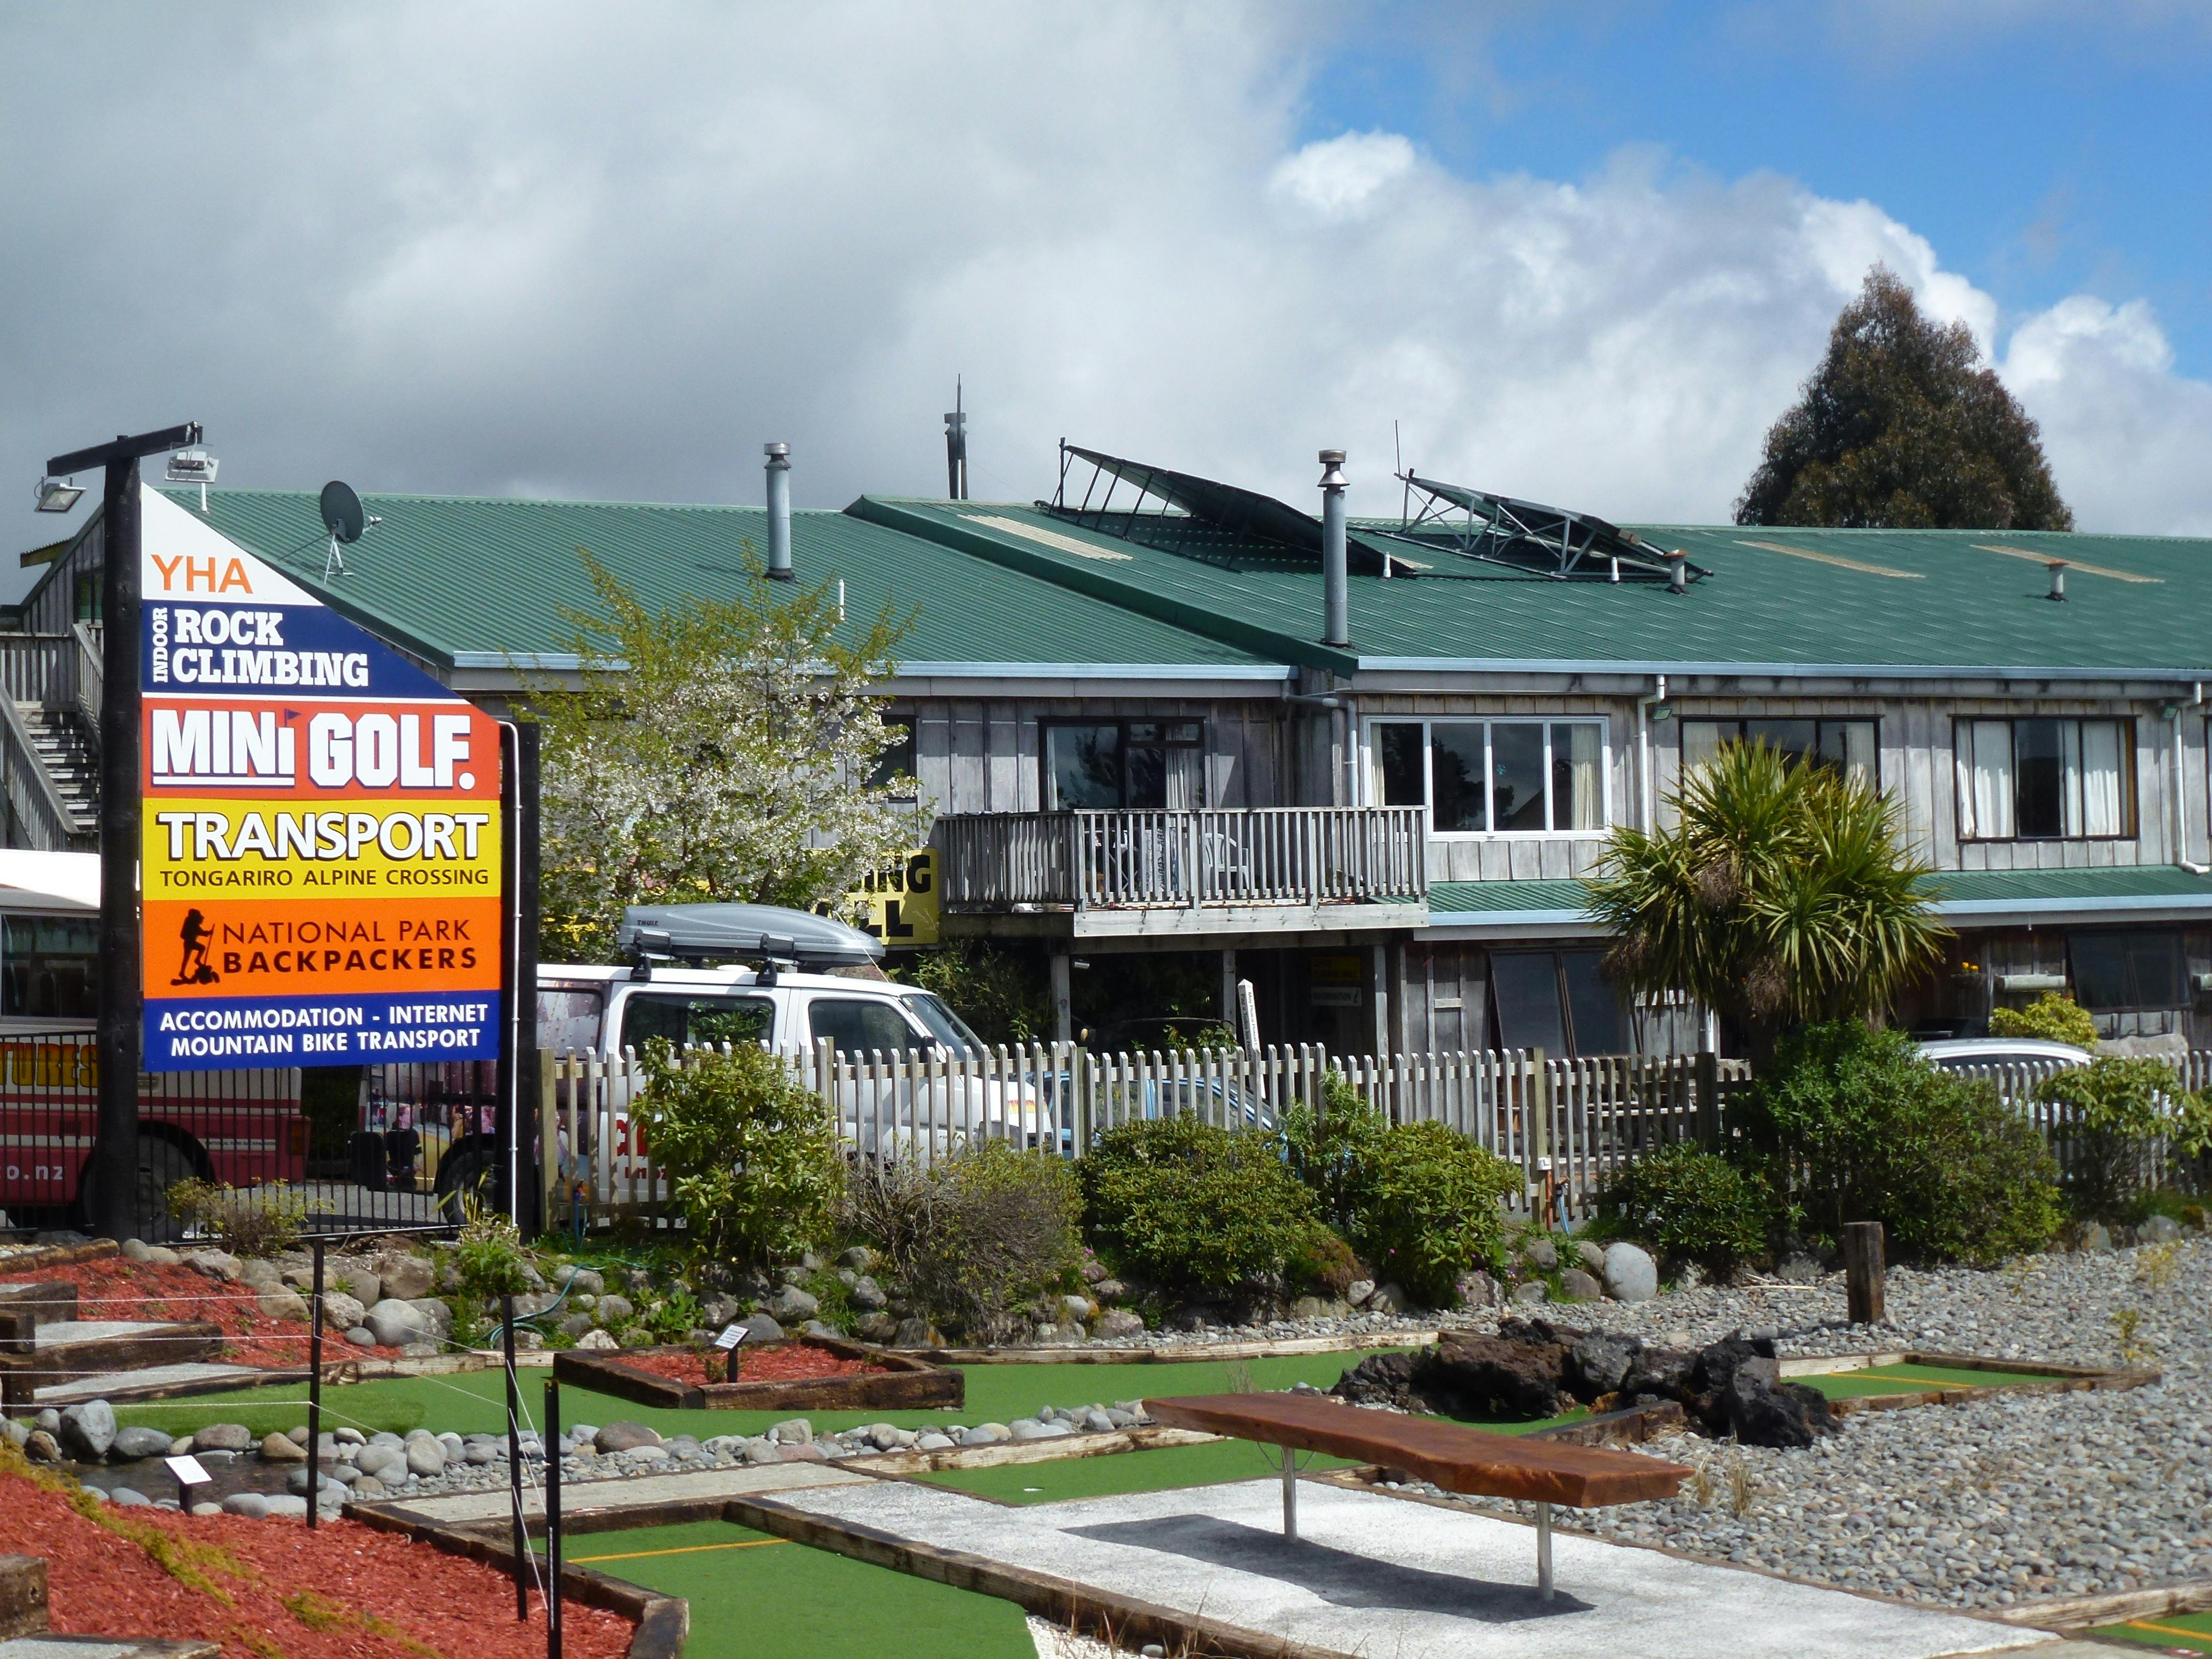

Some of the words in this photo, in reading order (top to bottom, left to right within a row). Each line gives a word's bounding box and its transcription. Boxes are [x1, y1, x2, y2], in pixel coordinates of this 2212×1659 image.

[151, 555, 253, 594] YHA
[175, 609, 283, 646] ROCK
[153, 607, 168, 683] INDOOR
[173, 649, 369, 686] CLIMBING
[156, 812, 489, 861] TRANSPORT
[160, 870, 292, 887] TONGARIRO
[303, 869, 376, 885] ALPINE
[387, 869, 489, 885] CROSSING
[223, 922, 385, 945] NATIONAL
[399, 919, 471, 941] PARK
[224, 947, 477, 973] BACKPACKERS
[160, 1007, 363, 1032] ACCOMMODATION
[390, 1004, 488, 1024] INTERNET
[171, 1035, 292, 1056] MOUNTAIN
[303, 1032, 347, 1052] BIKE
[357, 1029, 480, 1050] TRANSPORT
